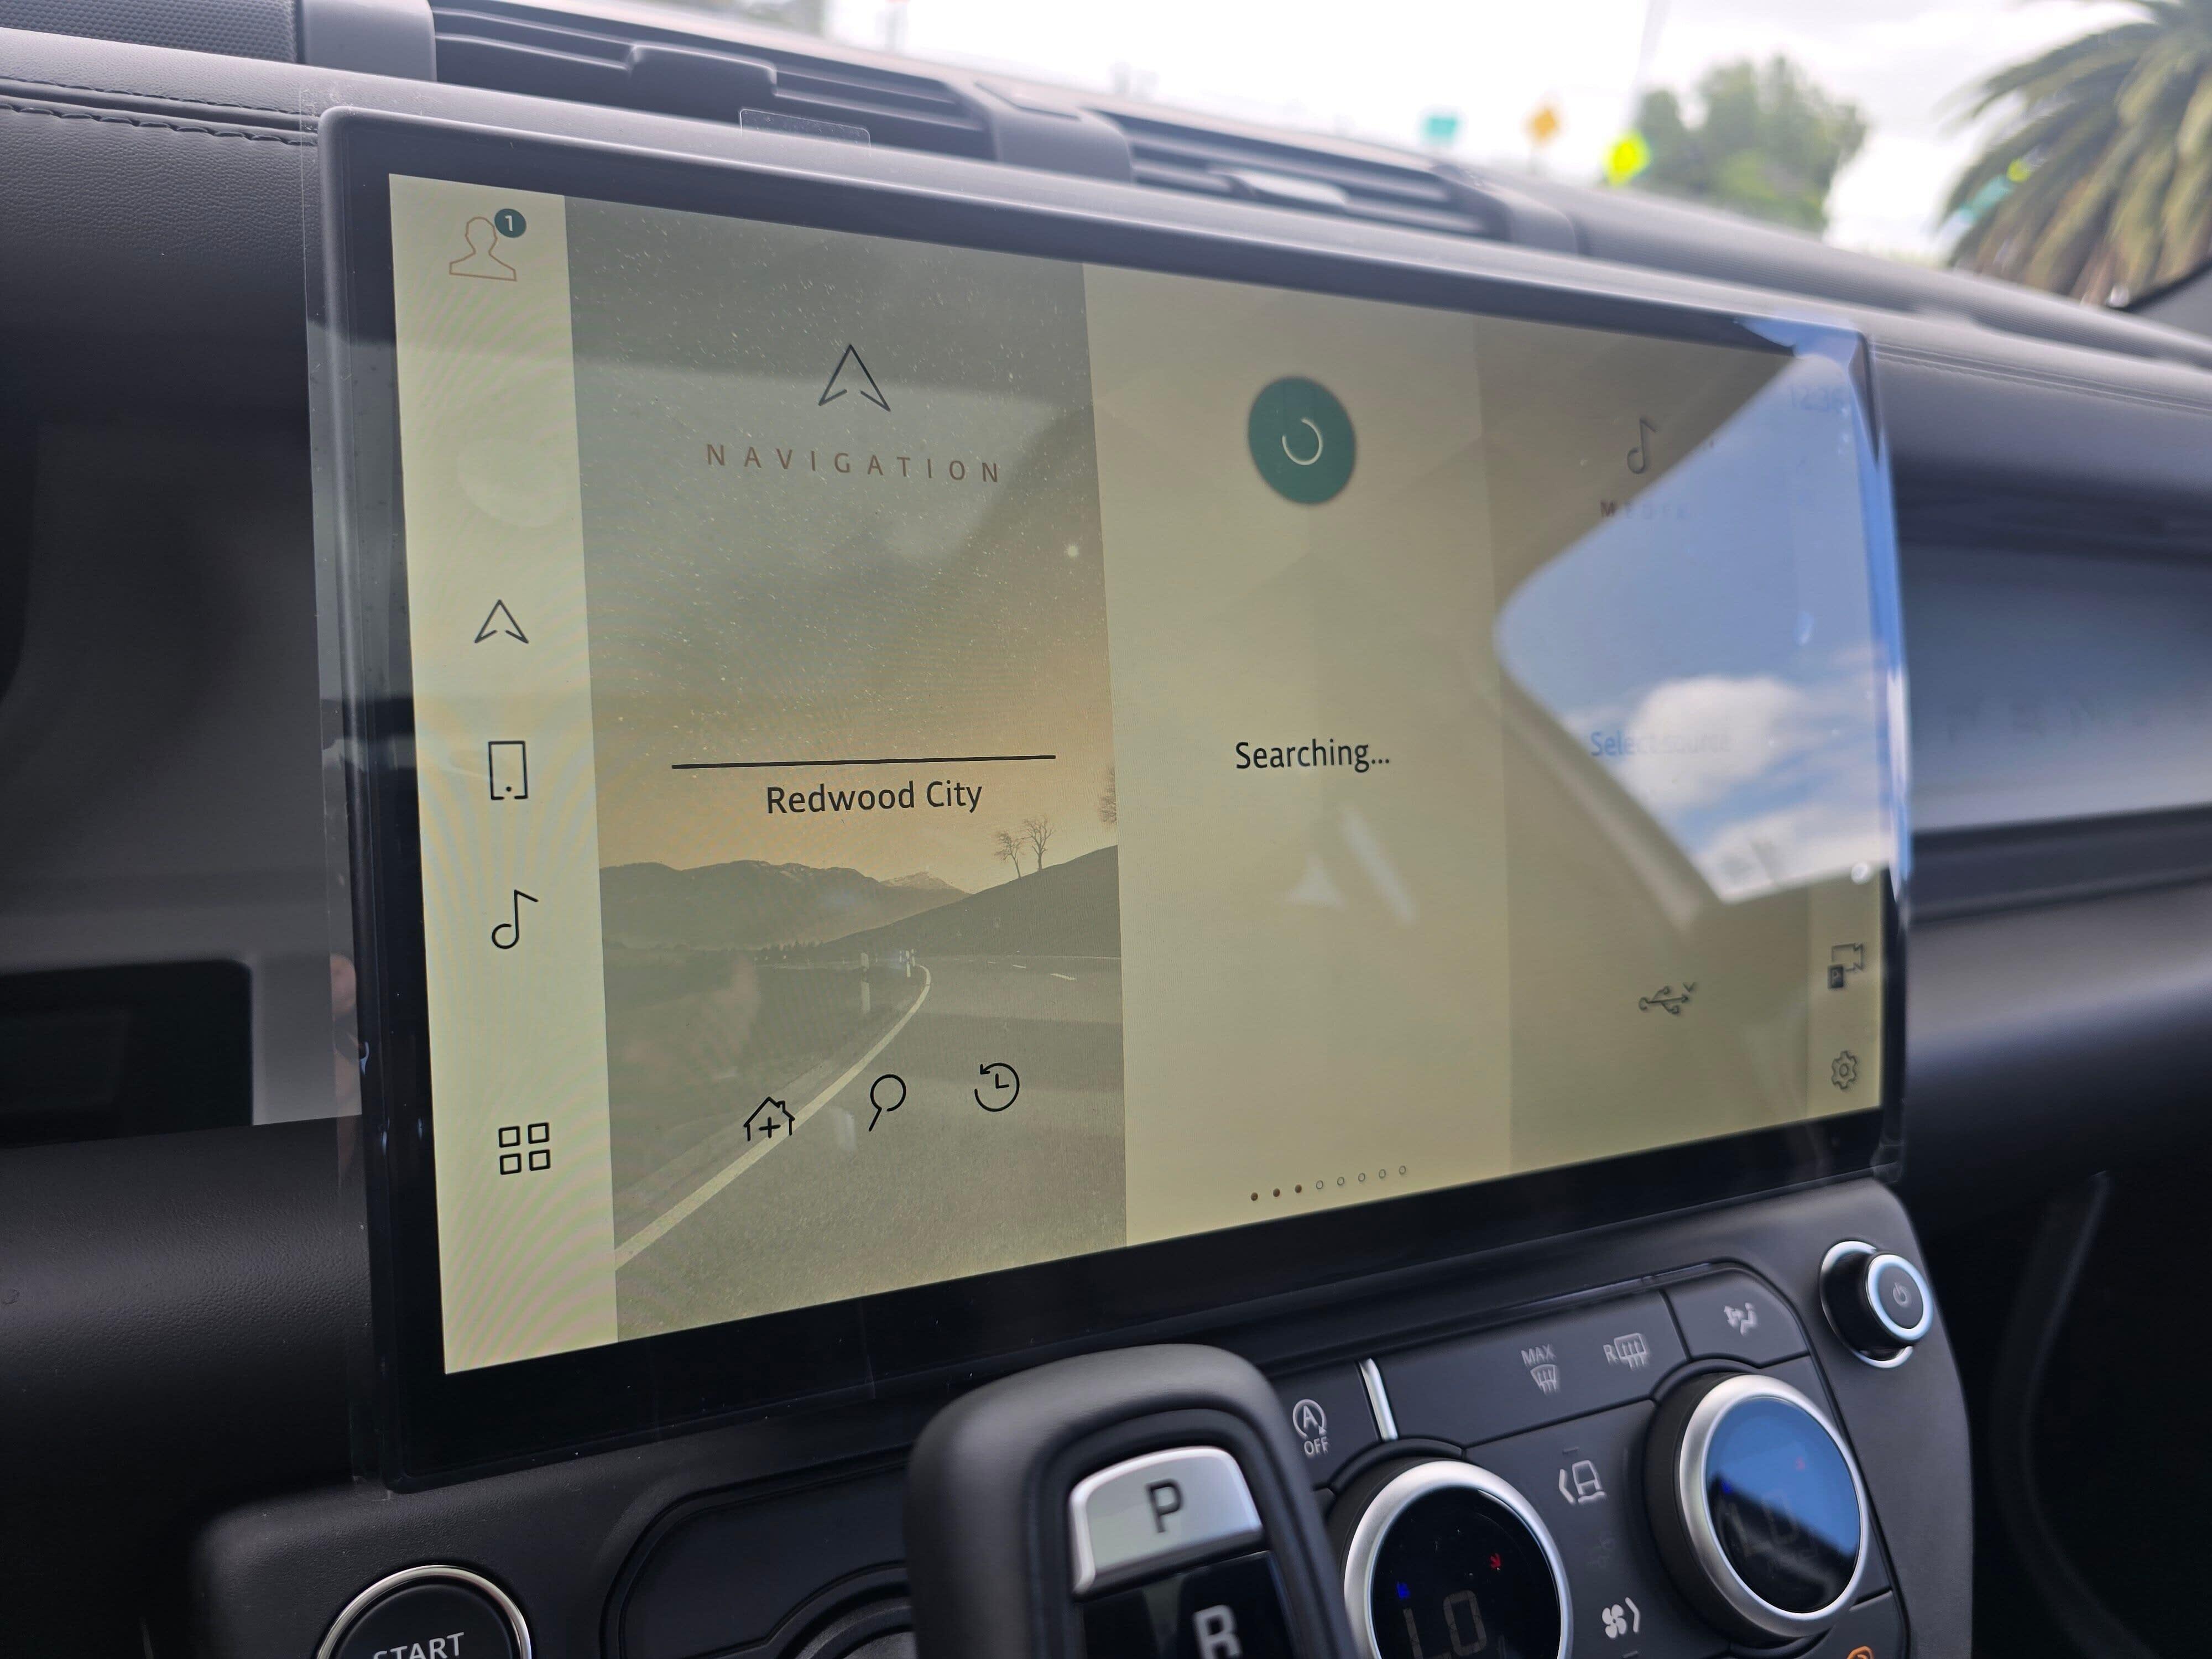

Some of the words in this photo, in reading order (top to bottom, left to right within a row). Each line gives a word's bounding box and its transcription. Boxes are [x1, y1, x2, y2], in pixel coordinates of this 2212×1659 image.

[504, 215, 513, 231] 1
[706, 443, 999, 483] NAVIGATION
[1235, 738, 1390, 773] Searching...
[766, 780, 915, 814] Redwood
[926, 779, 982, 813] City
[1521, 1343, 1557, 1366] MAX
[1603, 1344, 1619, 1366] R
[1304, 1436, 1329, 1456] OFF
[1145, 1478, 1183, 1533] P
[1193, 1604, 1243, 1659] R
